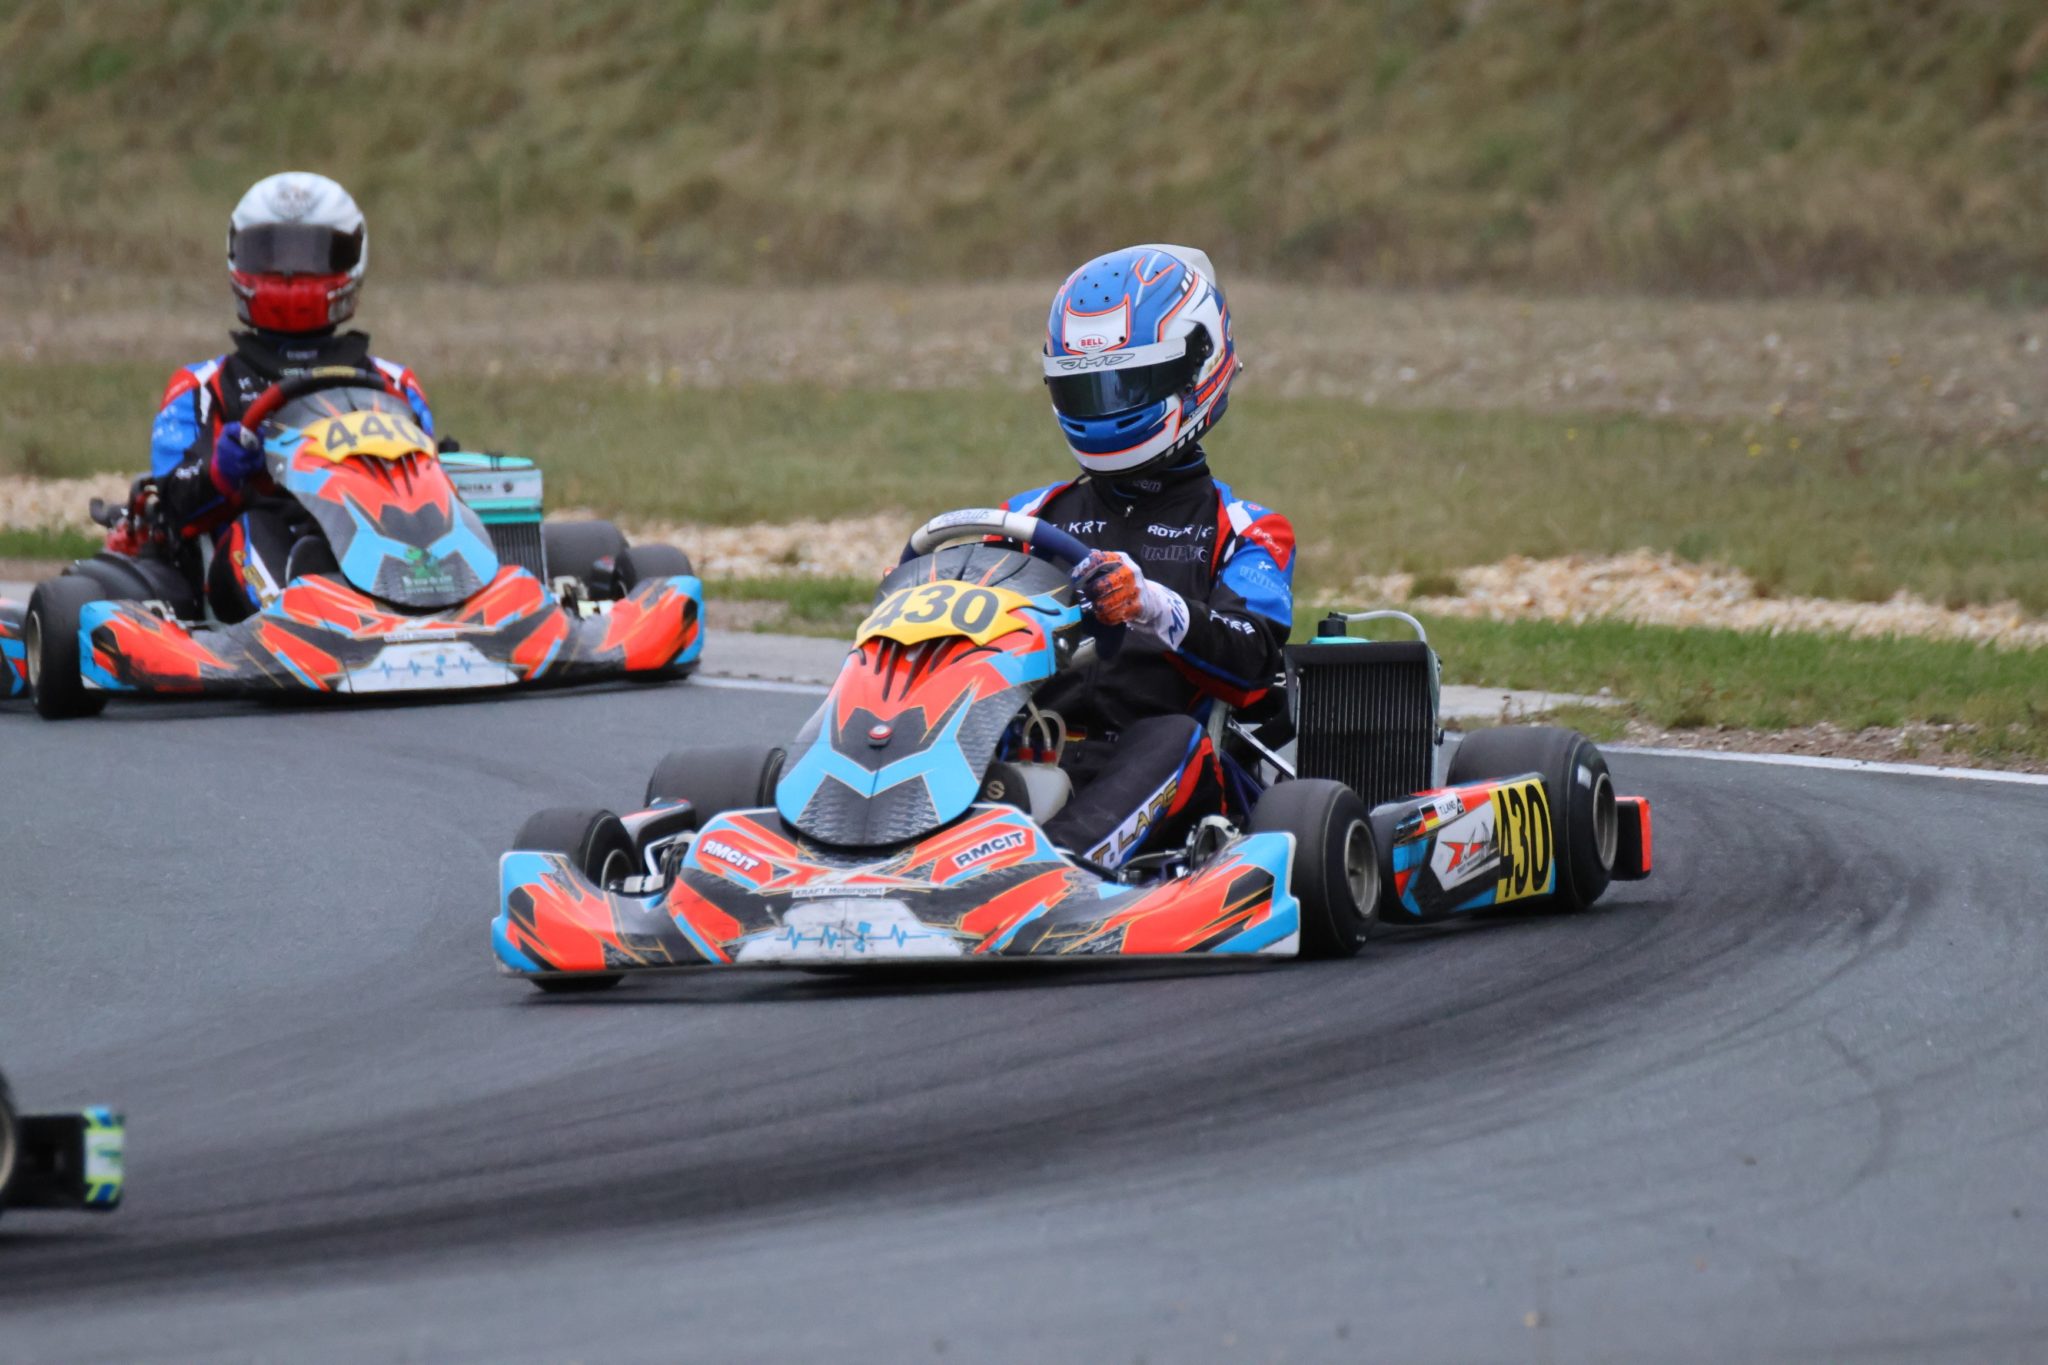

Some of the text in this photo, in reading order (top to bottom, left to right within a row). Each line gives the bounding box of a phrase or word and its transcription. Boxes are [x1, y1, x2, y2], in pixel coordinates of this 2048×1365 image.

[1080, 338, 1103, 347] BELL
[1068, 520, 1107, 535] KRT
[864, 584, 999, 634] 430
[702, 839, 760, 872] RMCIT
[954, 830, 1024, 867] RMCIT
[1497, 784, 1551, 898] 430
